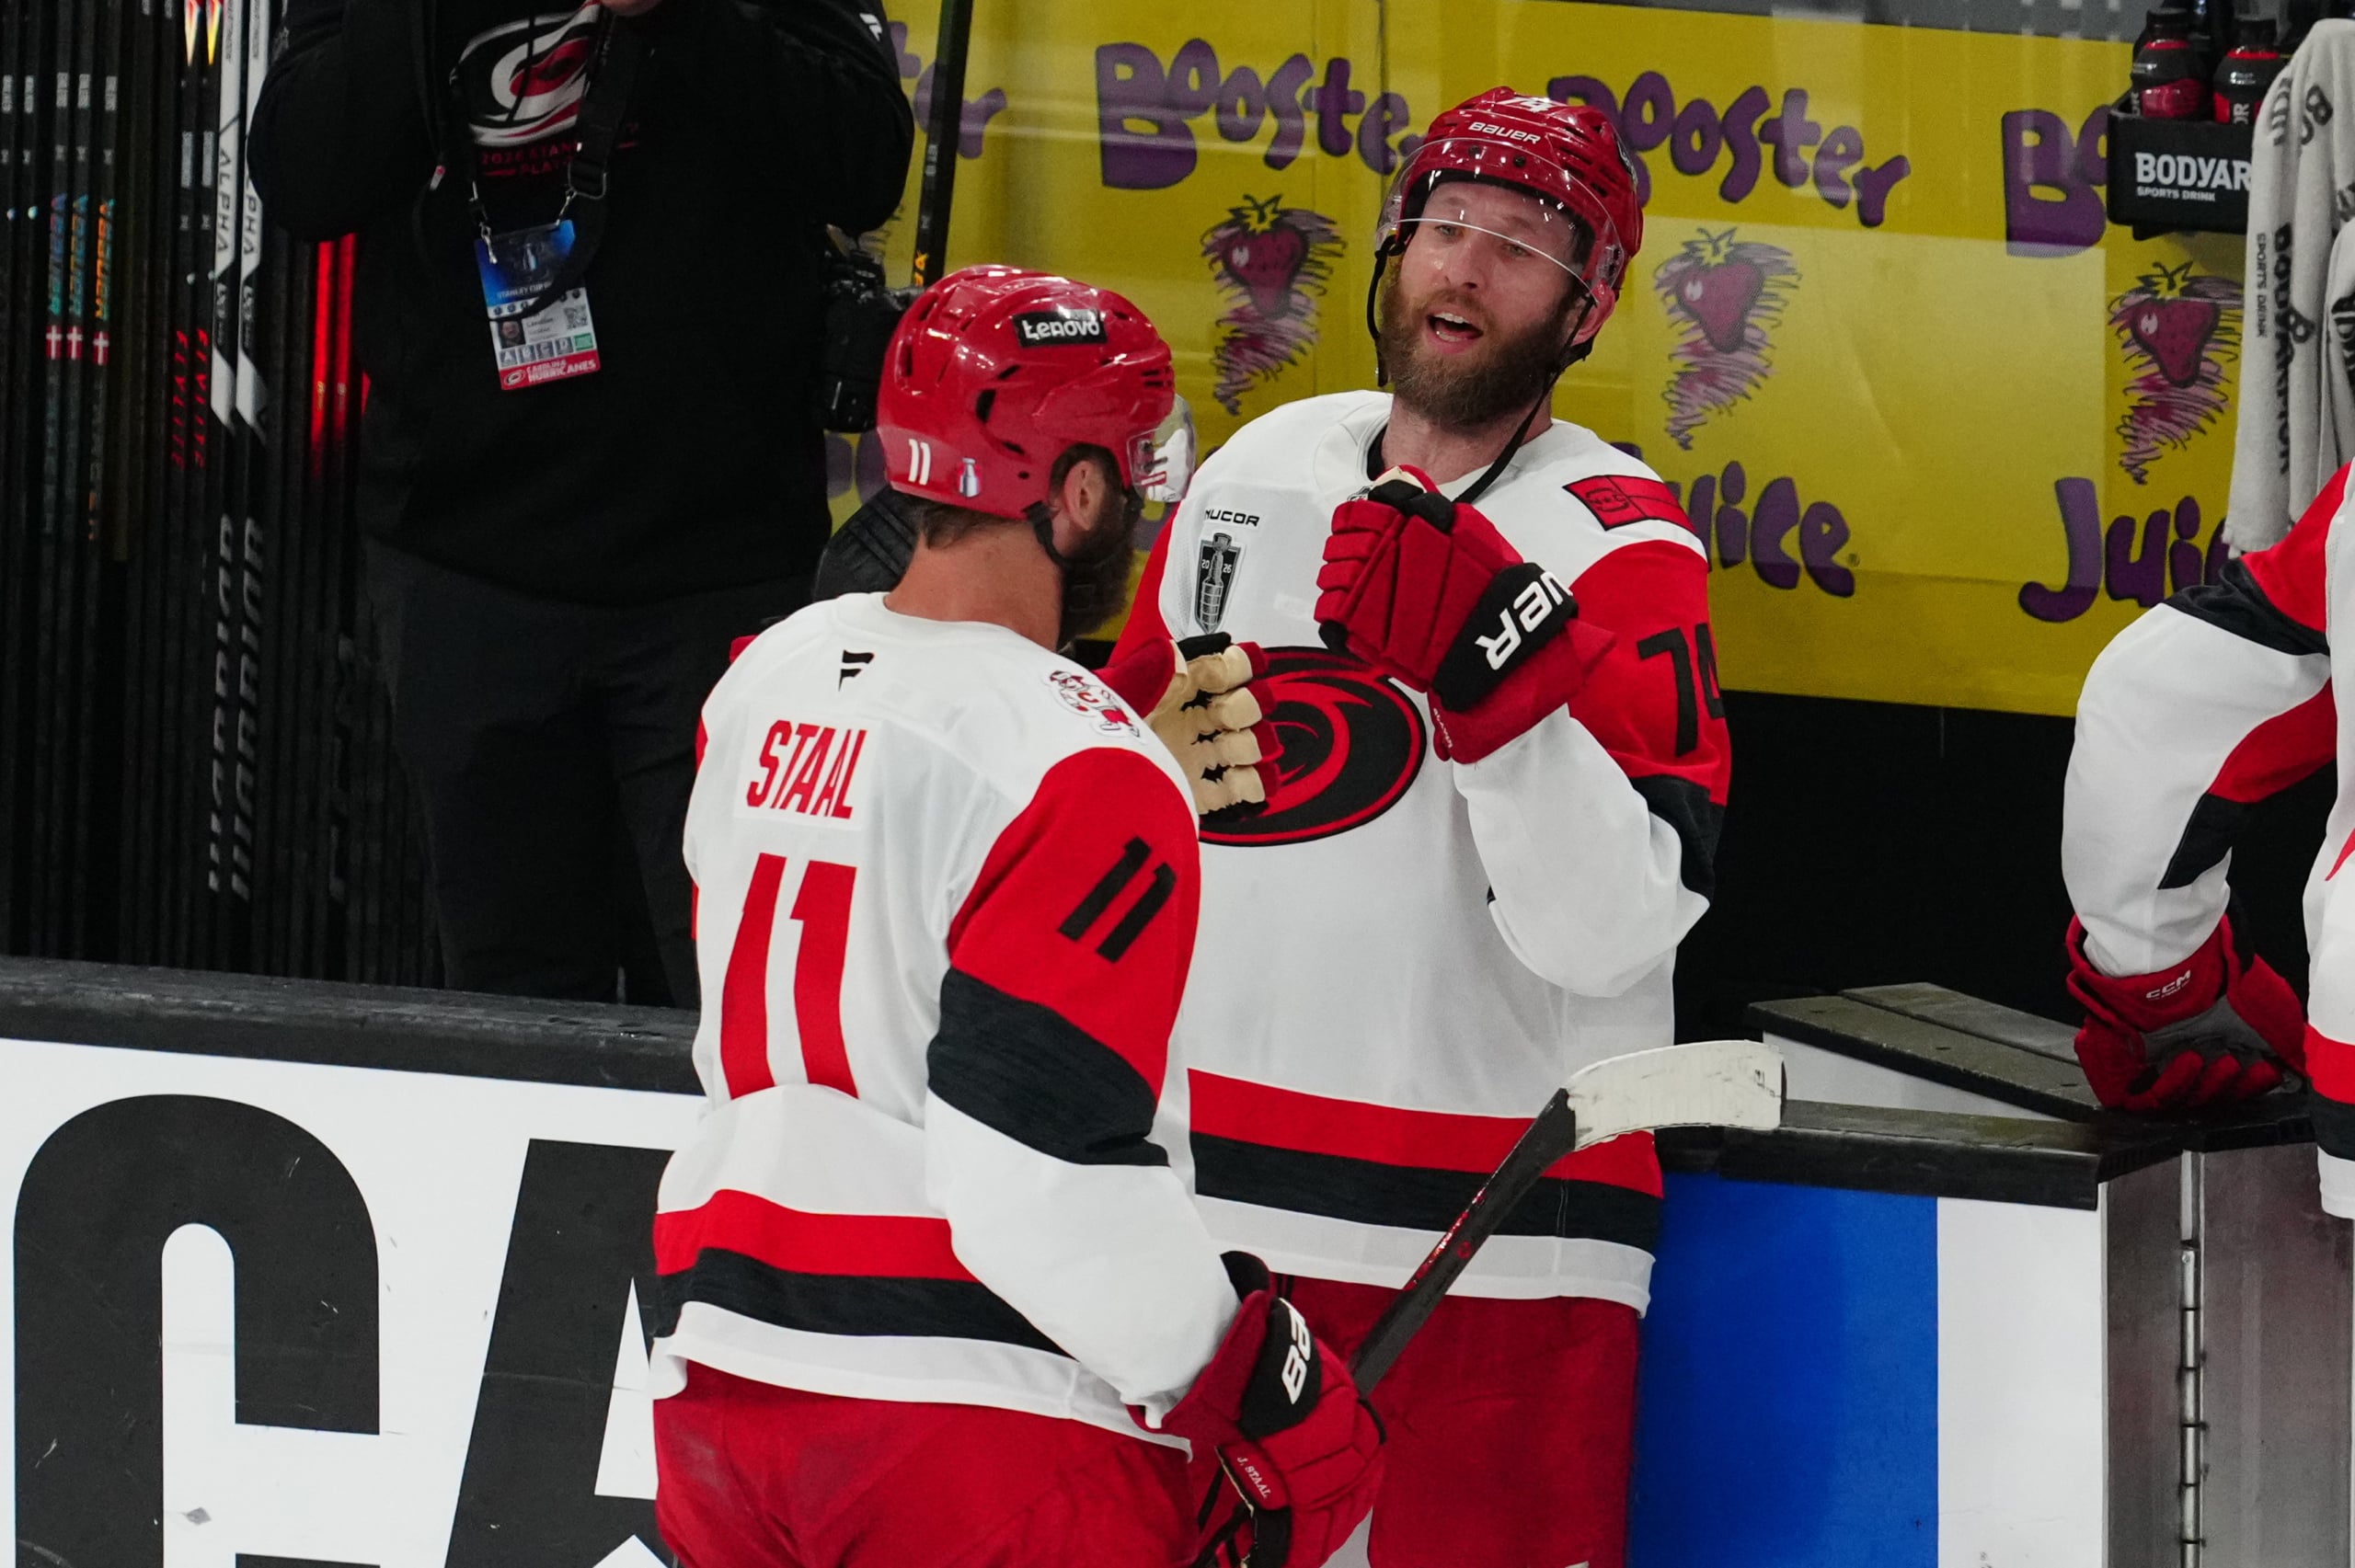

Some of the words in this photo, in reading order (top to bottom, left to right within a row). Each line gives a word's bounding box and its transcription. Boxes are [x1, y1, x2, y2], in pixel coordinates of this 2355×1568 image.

[1096, 38, 1419, 189] Booste
[2134, 152, 2253, 192] BODYAR
[2136, 187, 2179, 199] SPORTS
[2182, 189, 2216, 202] DRINK
[217, 149, 231, 252] ALPHA
[2257, 232, 2268, 290] SPORTS
[1021, 319, 1101, 341] Lenovo
[2257, 293, 2269, 338] DRINK
[908, 439, 931, 486] 11
[1205, 509, 1260, 527] NUCOR
[1647, 451, 1855, 598] ice
[1201, 559, 1211, 570] 20
[1223, 563, 1233, 574] 26
[2018, 476, 2232, 624] Jui
[1475, 570, 1574, 670] UER
[746, 719, 867, 819] STAAL
[1057, 834, 1178, 965] 11
[720, 852, 860, 1102] 11
[2145, 969, 2191, 999] CCM
[1245, 1466, 1271, 1499] STAAL
